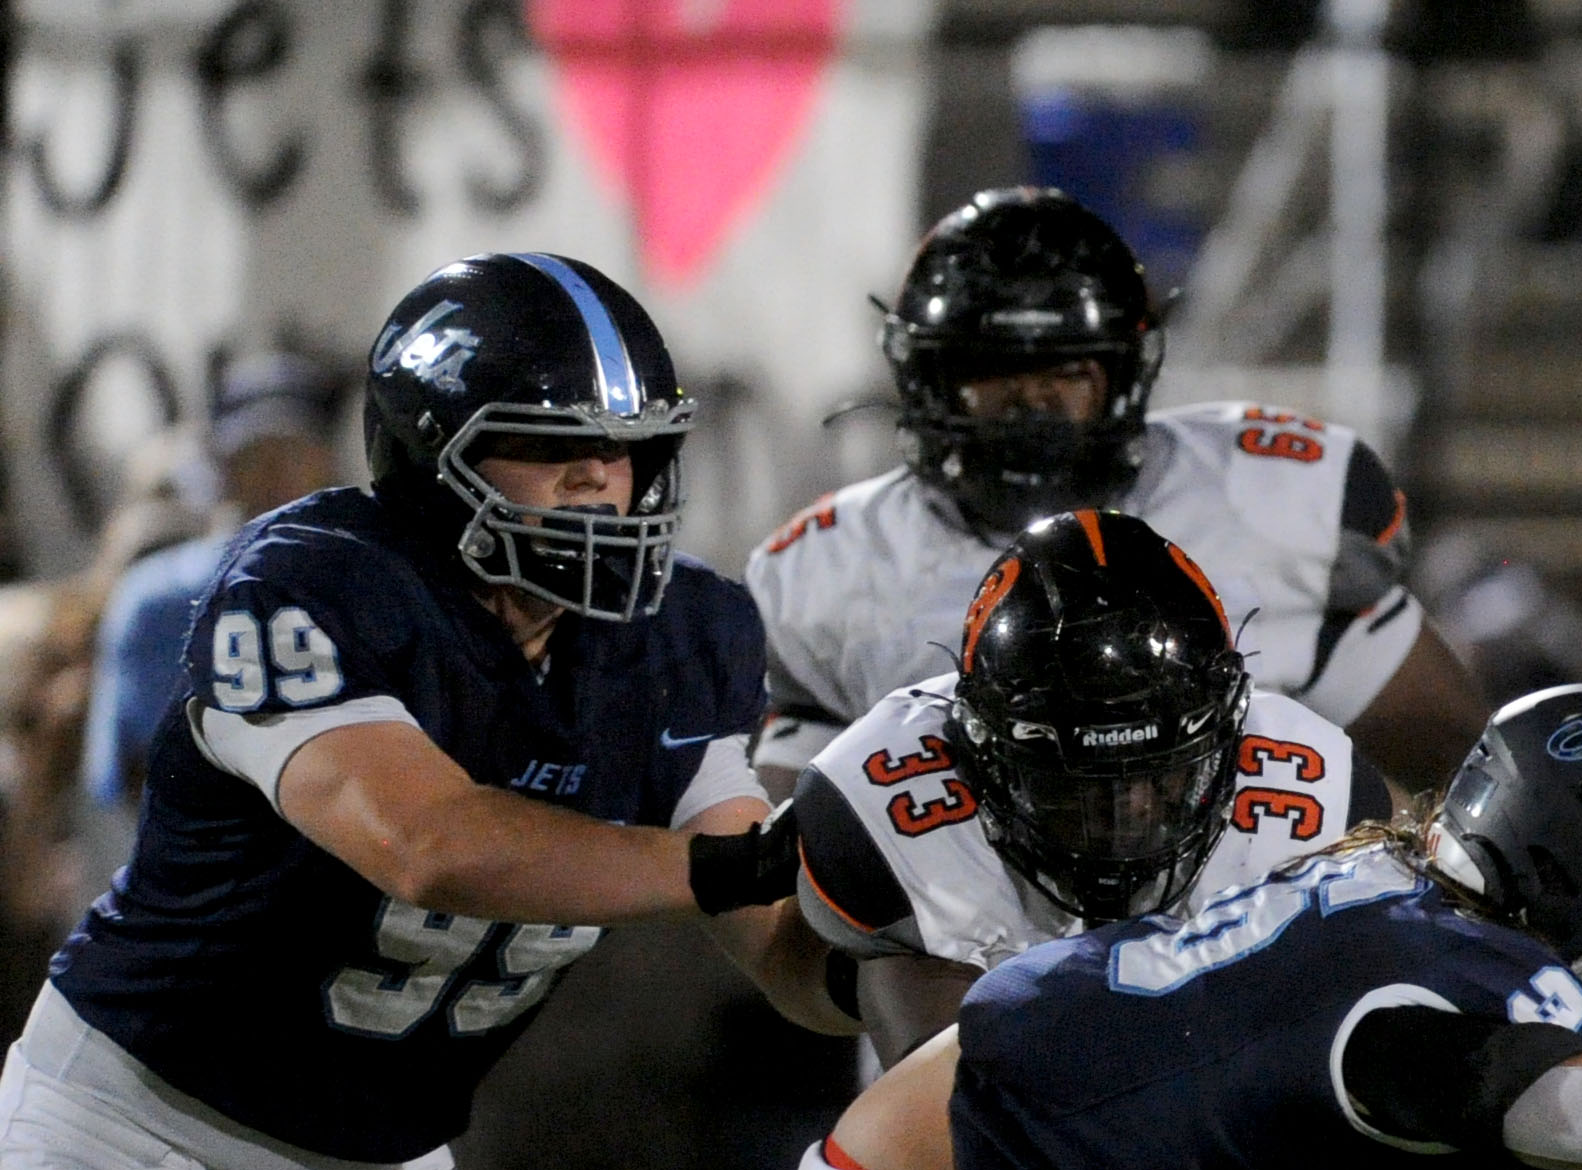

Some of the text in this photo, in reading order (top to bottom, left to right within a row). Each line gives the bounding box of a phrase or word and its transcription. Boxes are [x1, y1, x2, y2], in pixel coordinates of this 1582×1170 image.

[212, 606, 345, 713] 99
[510, 759, 588, 796] JETS
[862, 734, 979, 838] 33
[1082, 724, 1159, 747] Riddell
[1230, 733, 1325, 842] 33
